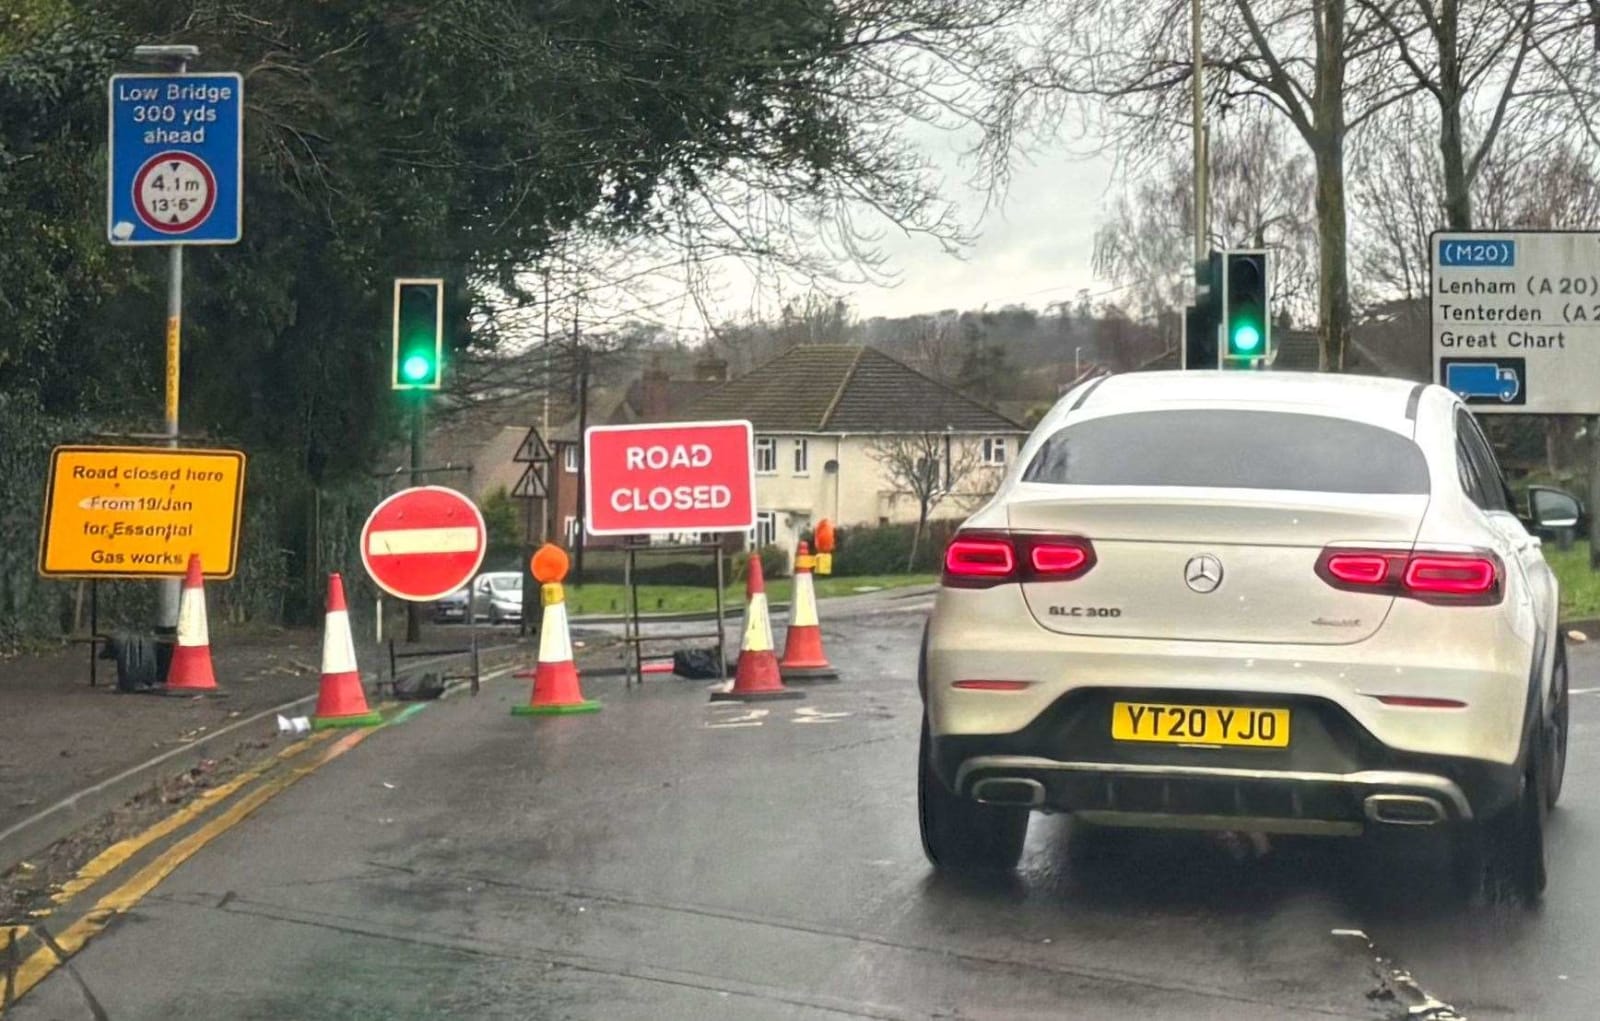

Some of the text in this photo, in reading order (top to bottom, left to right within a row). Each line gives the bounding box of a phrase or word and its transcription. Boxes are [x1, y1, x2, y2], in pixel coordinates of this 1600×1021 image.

[119, 83, 232, 103] Low Bridge
[133, 105, 217, 125] 300 yds
[144, 127, 205, 144] ahead
[1445, 243, 1509, 264] (M20)
[1438, 277, 1516, 295] Lenham
[1440, 304, 1542, 321] Tenterden
[1440, 330, 1566, 348] Great Chart
[626, 443, 713, 471] ROAD
[72, 465, 224, 483] Road closed here
[89, 495, 193, 512] From 19/Jan
[610, 484, 732, 513] CLOSED
[83, 521, 193, 538] for Essential
[91, 550, 184, 565] Gas works
[1127, 704, 1276, 741] YT20 YJO
